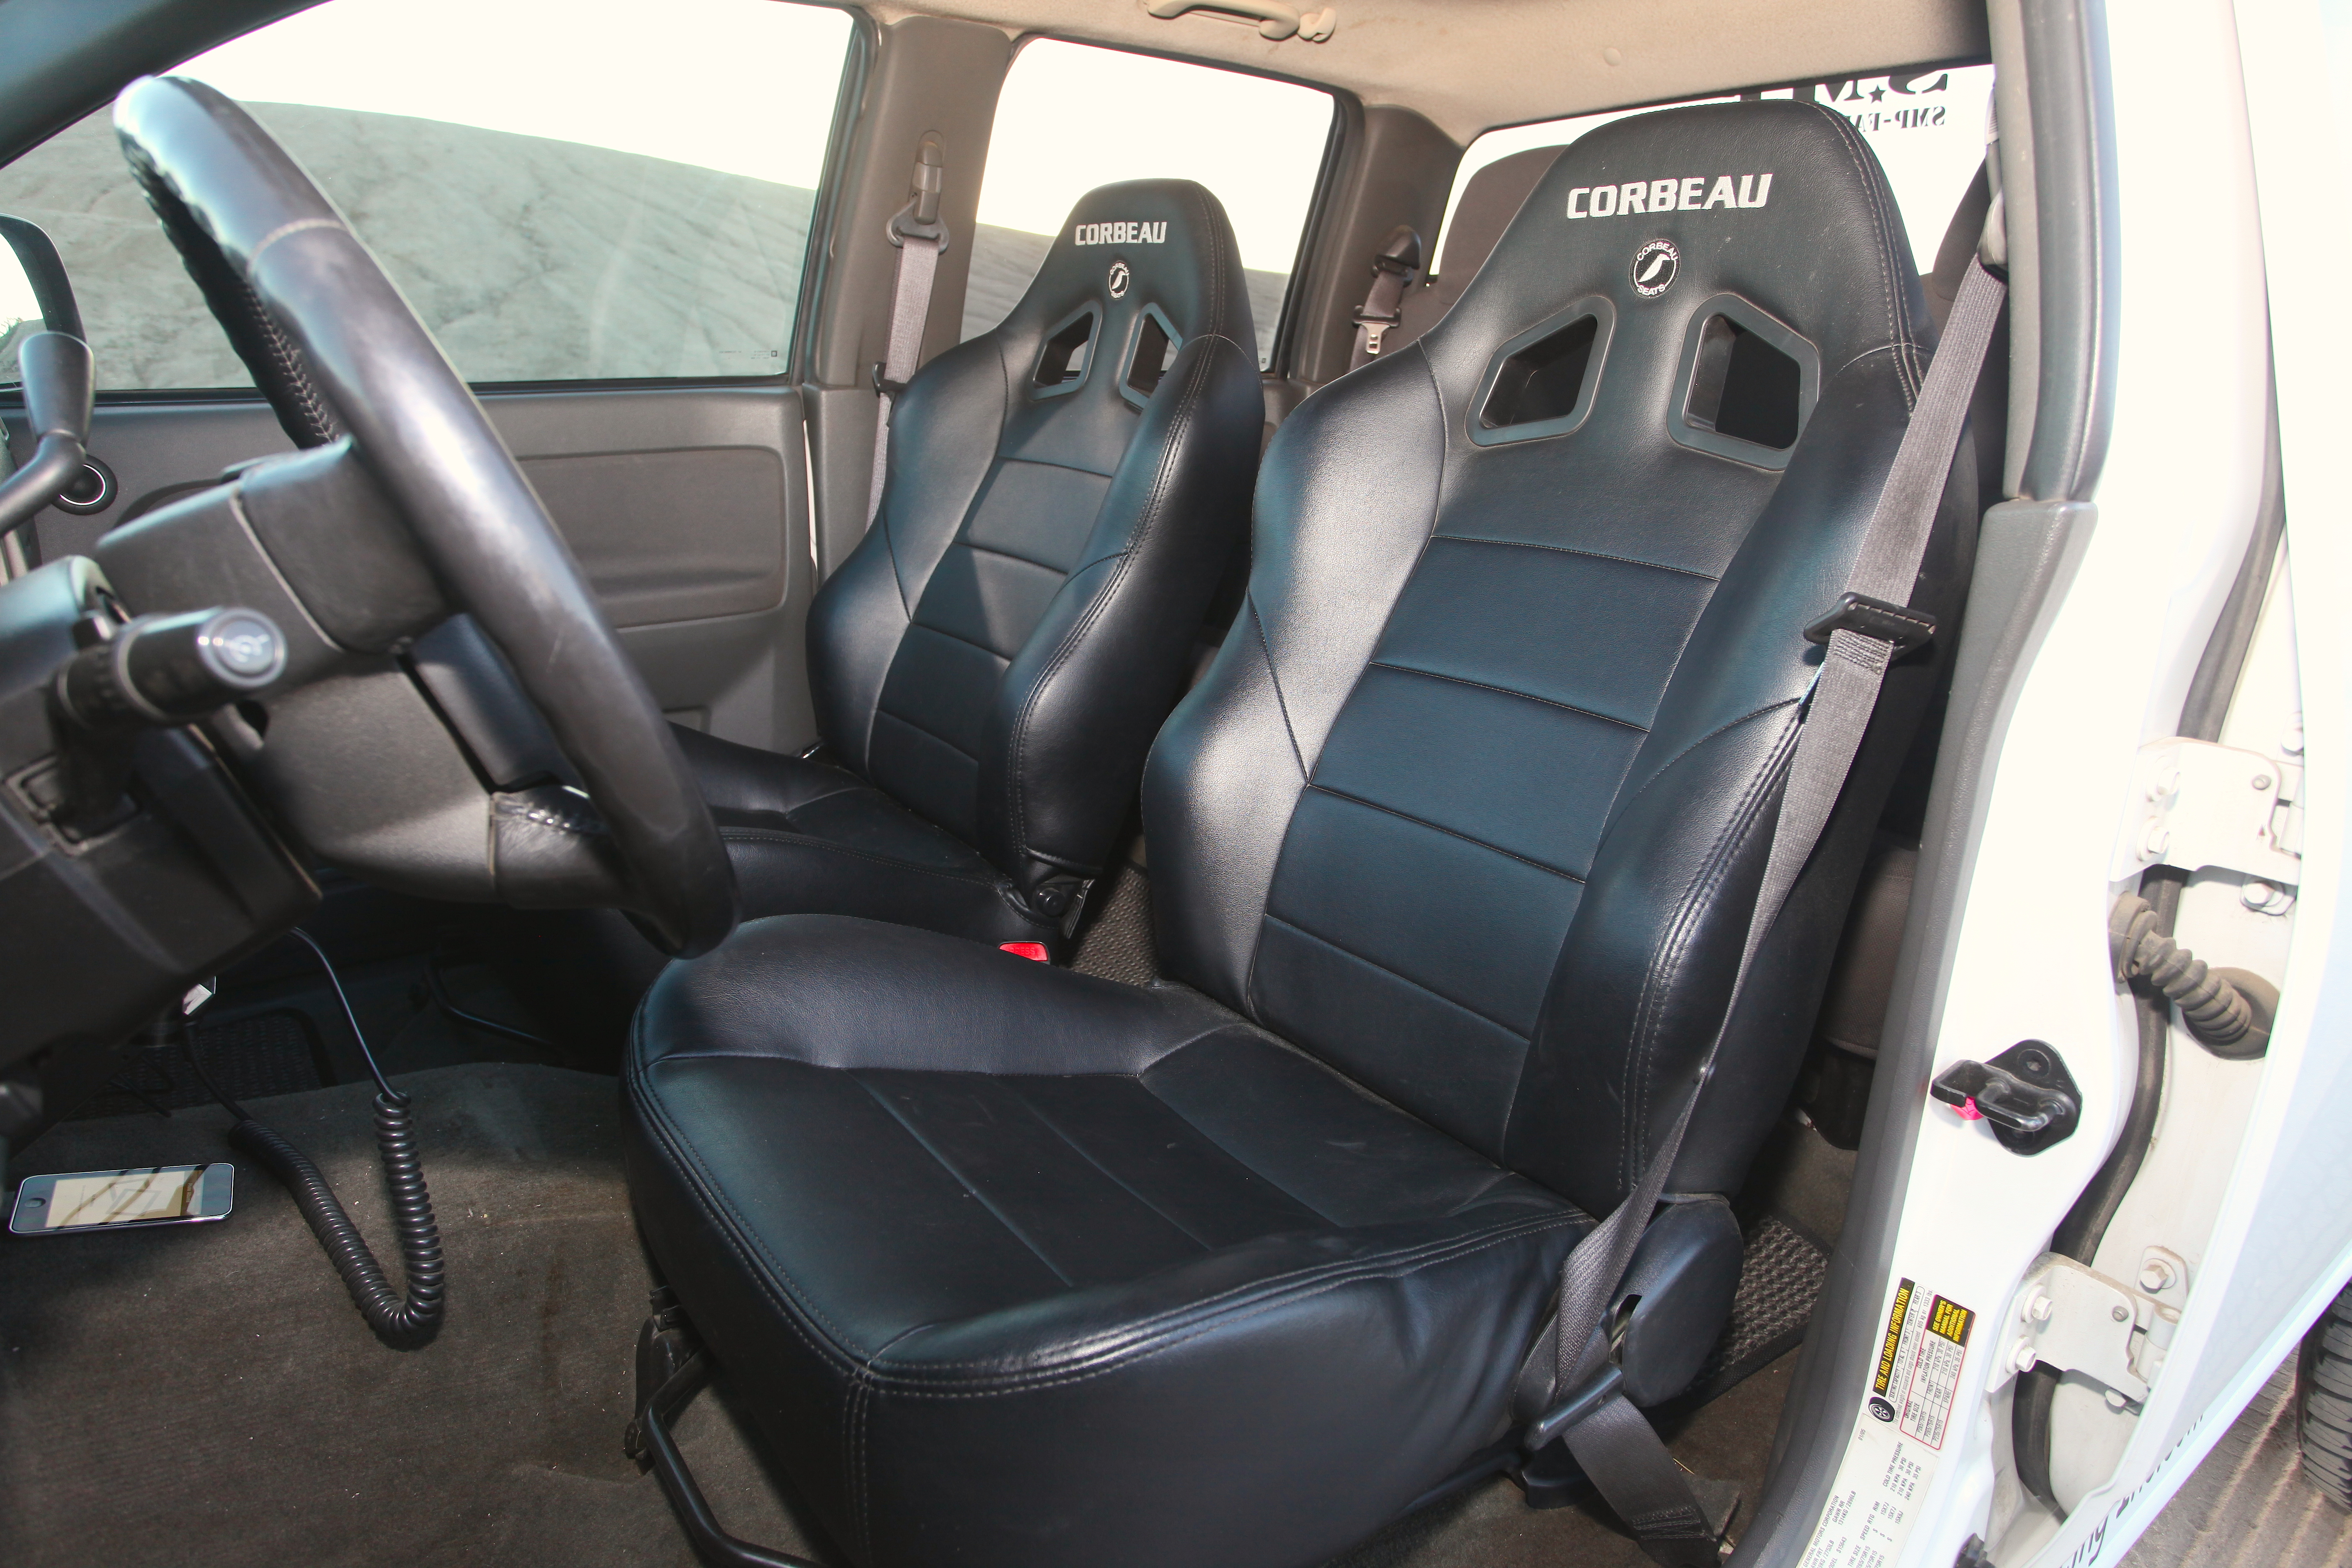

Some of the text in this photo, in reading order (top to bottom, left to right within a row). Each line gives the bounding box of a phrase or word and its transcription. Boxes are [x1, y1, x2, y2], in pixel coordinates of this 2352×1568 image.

[1567, 173, 1773, 219] CORBEAU
[1075, 222, 1167, 245] CORBEAU
[1637, 242, 1678, 261] CORBEAU
[1110, 263, 1130, 276] CORBEAU
[1638, 284, 1666, 296] SEATS
[1934, 1300, 1946, 1323] OWNER'S
[1939, 1302, 1953, 1334] MANUAL FOR
[1946, 1307, 1960, 1337] ADDITIONAL
[1952, 1309, 1967, 1342] INFORMATION
[1875, 1288, 1909, 1390] TIRE AND LOADING INFORMATION
[1892, 1367, 1901, 1385] CAPACITY
[1920, 1340, 1935, 1383] INFLATION PRESSURE
[1903, 1399, 1912, 1418] ORIGINAL
[1916, 1410, 1926, 1433] P265/75R15
[1924, 1414, 1935, 1437] P265/75R15
[1934, 1387, 1942, 1399] REAR
[1932, 1418, 1943, 1442] P235/75R15
[1942, 1389, 1951, 1403] SPARE
[1847, 1555, 1856, 1567] TIRE
[1853, 1545, 1861, 1556] SIZE
[1860, 1525, 1870, 1540] SPEED
[1891, 1442, 1903, 1464] PRESSURE
[1888, 1506, 1896, 1519] 15X7J
[1895, 1510, 1903, 1524] 15X6J
[1803, 1494, 1839, 1568] GENERAL MOTORS CORPORATION
[1810, 1558, 1819, 1568] AWR
[1832, 1508, 1842, 1523] GAWR
[1839, 1500, 1845, 1509] RR
[1822, 1540, 1834, 1559] /2753LB
[1838, 1509, 1848, 1526] 1314KG
[1846, 1490, 1856, 1510] /2896LB
[1855, 1545, 1870, 1568] 265/75R15
[1880, 1501, 1889, 1515] 15X7J
[1827, 1536, 1847, 1568] ODEL S15643
